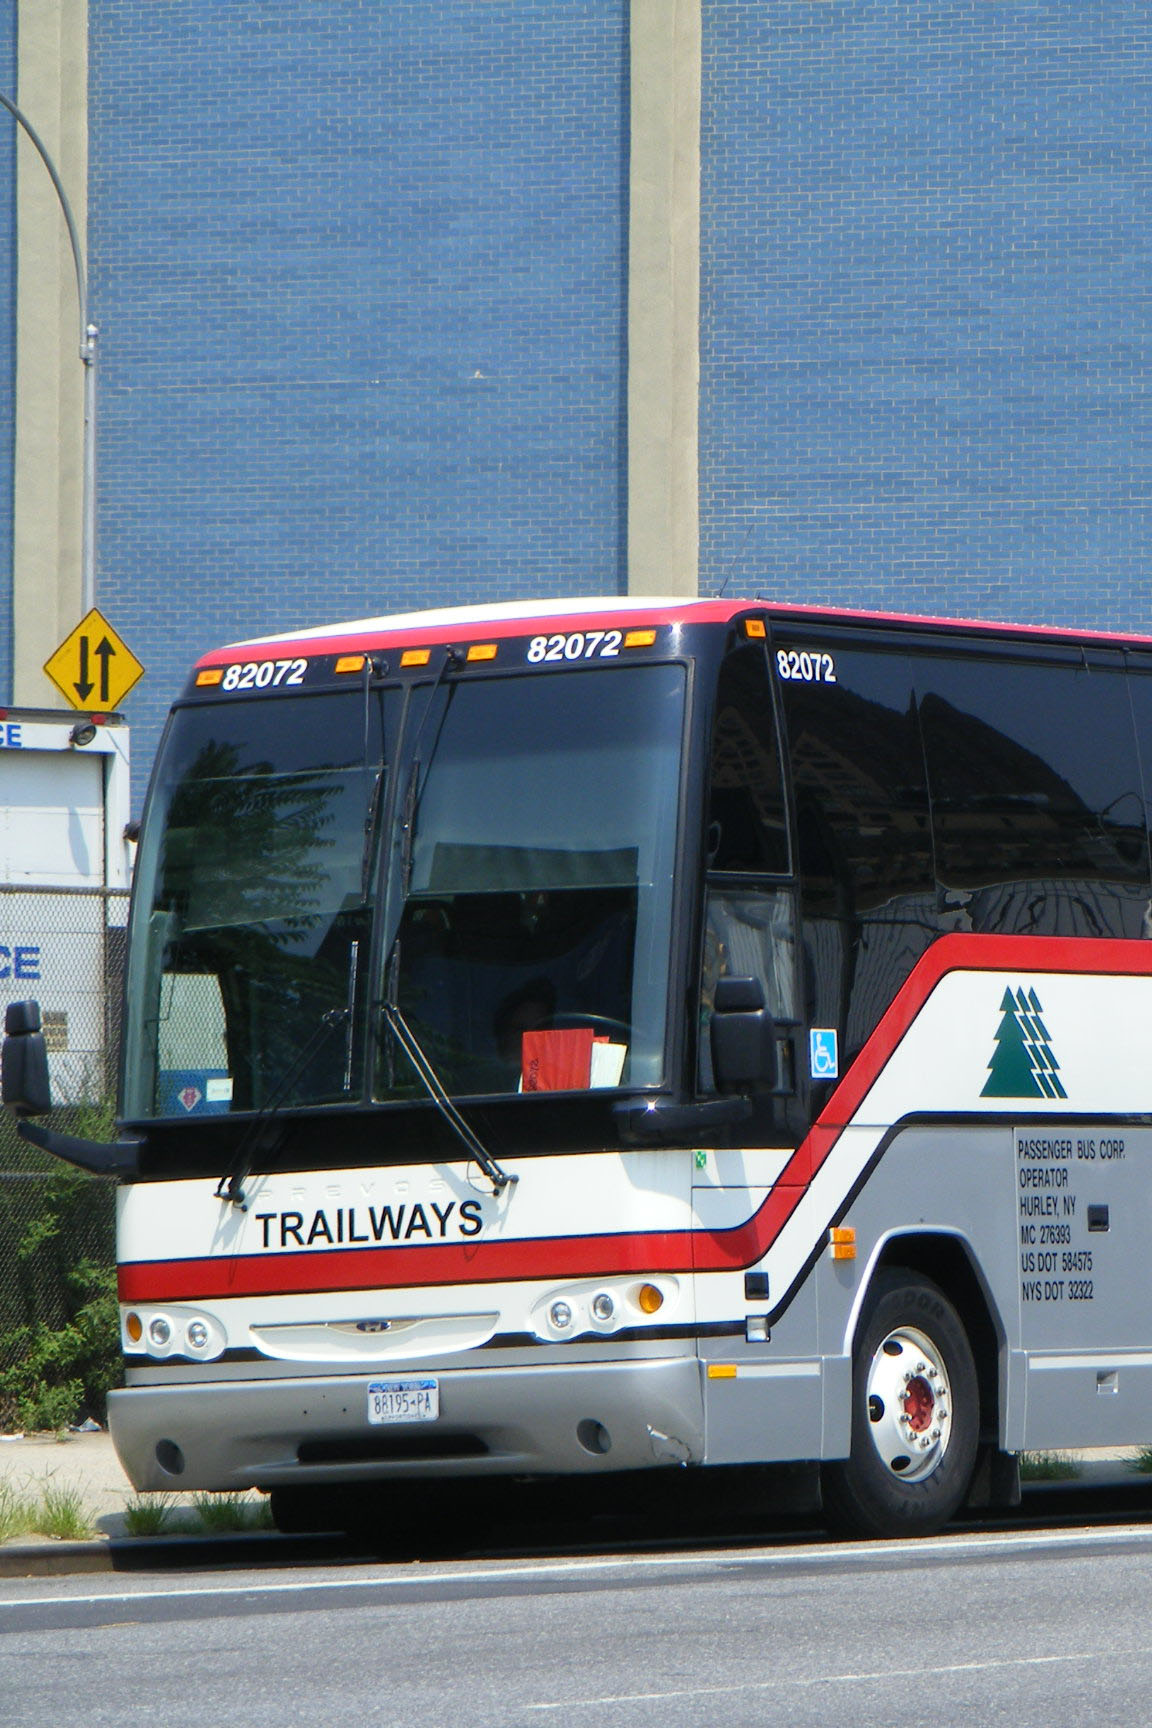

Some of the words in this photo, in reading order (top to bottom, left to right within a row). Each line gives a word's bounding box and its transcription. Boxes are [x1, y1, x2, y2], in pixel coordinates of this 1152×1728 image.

[527, 630, 622, 663] 82072
[222, 658, 308, 691] 82072
[777, 649, 837, 682] 82072
[1018, 1140, 1073, 1160] PASSENGER
[1077, 1140, 1096, 1160] BUS
[1100, 1140, 1126, 1160] CORP.
[1019, 1168, 1069, 1188] OPERATOR
[1020, 1196, 1060, 1218] HURLEY,
[1063, 1196, 1076, 1216] NY
[255, 1199, 483, 1248] TRAILWAYS
[1021, 1225, 1037, 1244] MC
[1040, 1224, 1071, 1244] 276393
[1021, 1253, 1035, 1272] US
[1038, 1252, 1058, 1272] DOT
[1062, 1251, 1093, 1272] 584575
[1022, 1282, 1042, 1301] NYS
[1045, 1281, 1065, 1300] DOT
[1068, 1281, 1094, 1300] 32322
